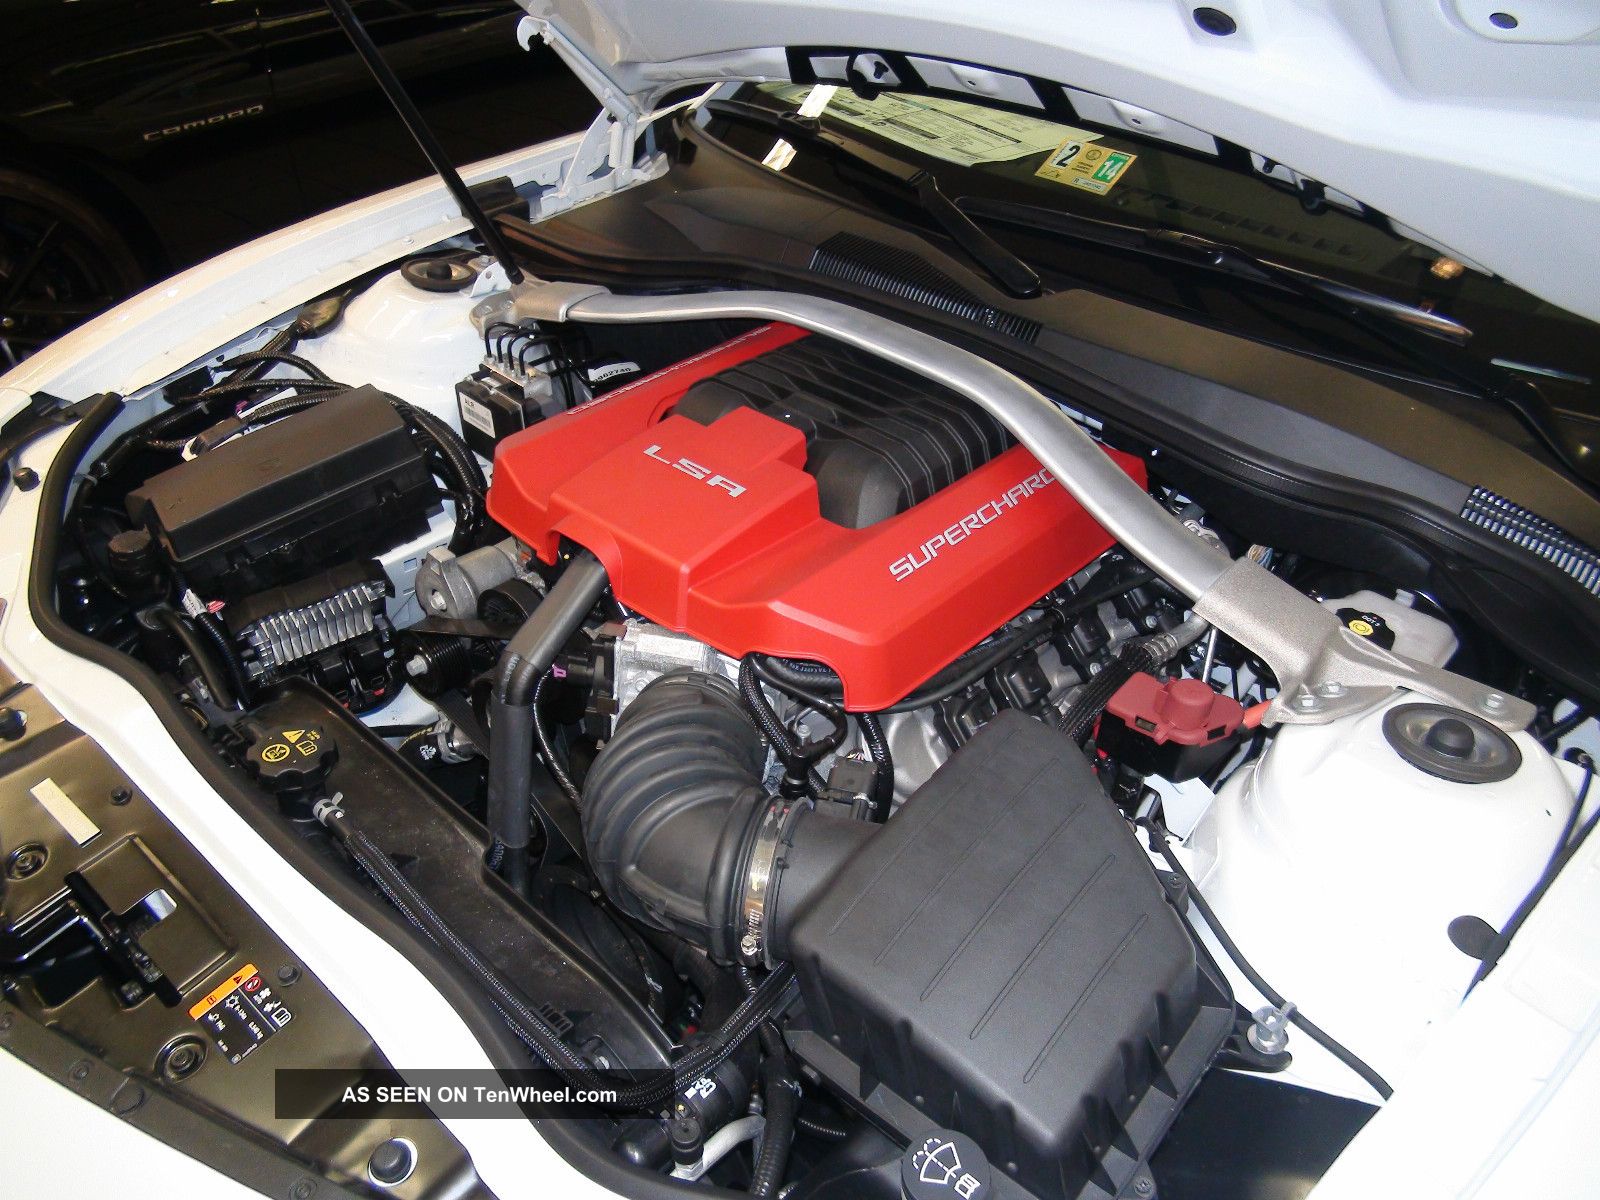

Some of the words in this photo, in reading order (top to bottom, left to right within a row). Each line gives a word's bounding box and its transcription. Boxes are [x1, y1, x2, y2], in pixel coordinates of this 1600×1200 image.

[1056, 145, 1081, 167] 2
[1097, 160, 1124, 180] 14
[643, 445, 747, 498] LSA
